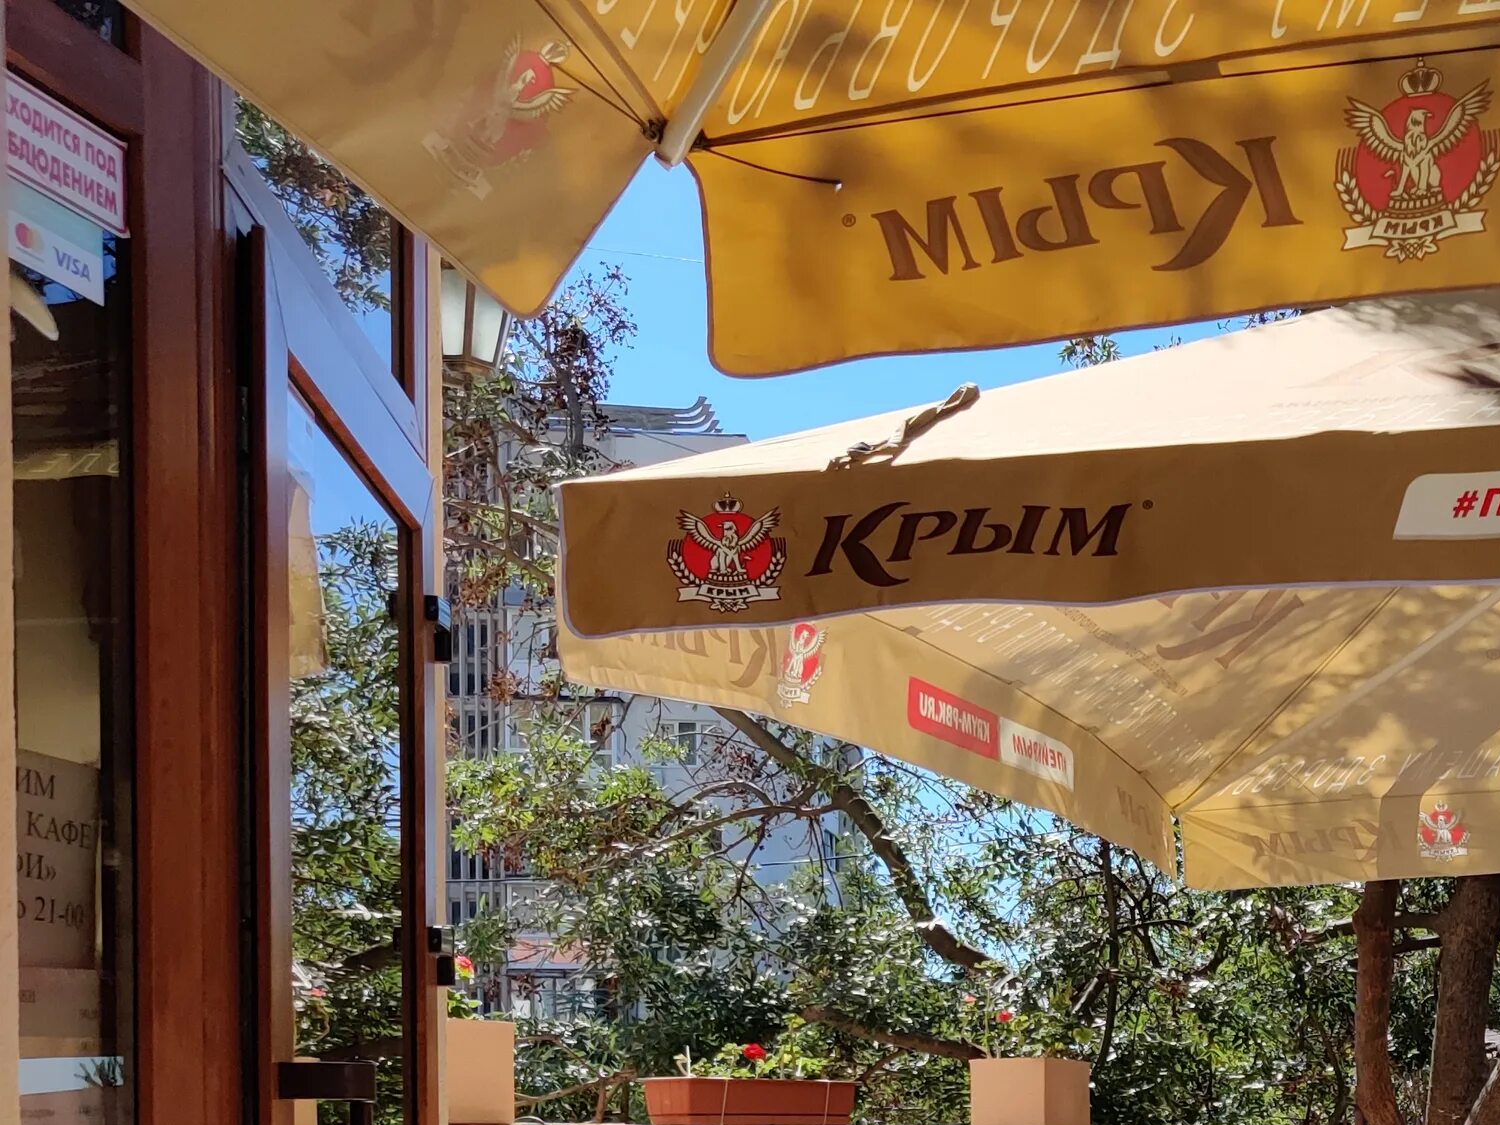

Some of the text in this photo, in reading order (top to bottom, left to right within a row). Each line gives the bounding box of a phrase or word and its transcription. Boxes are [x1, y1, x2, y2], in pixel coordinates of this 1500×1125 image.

[5, 94, 118, 183] ХОДИТСЯ ПОД
[52, 246, 92, 283] VISA
[26, 810, 91, 850] КАФЕ
[33, 896, 85, 930] 21-00
